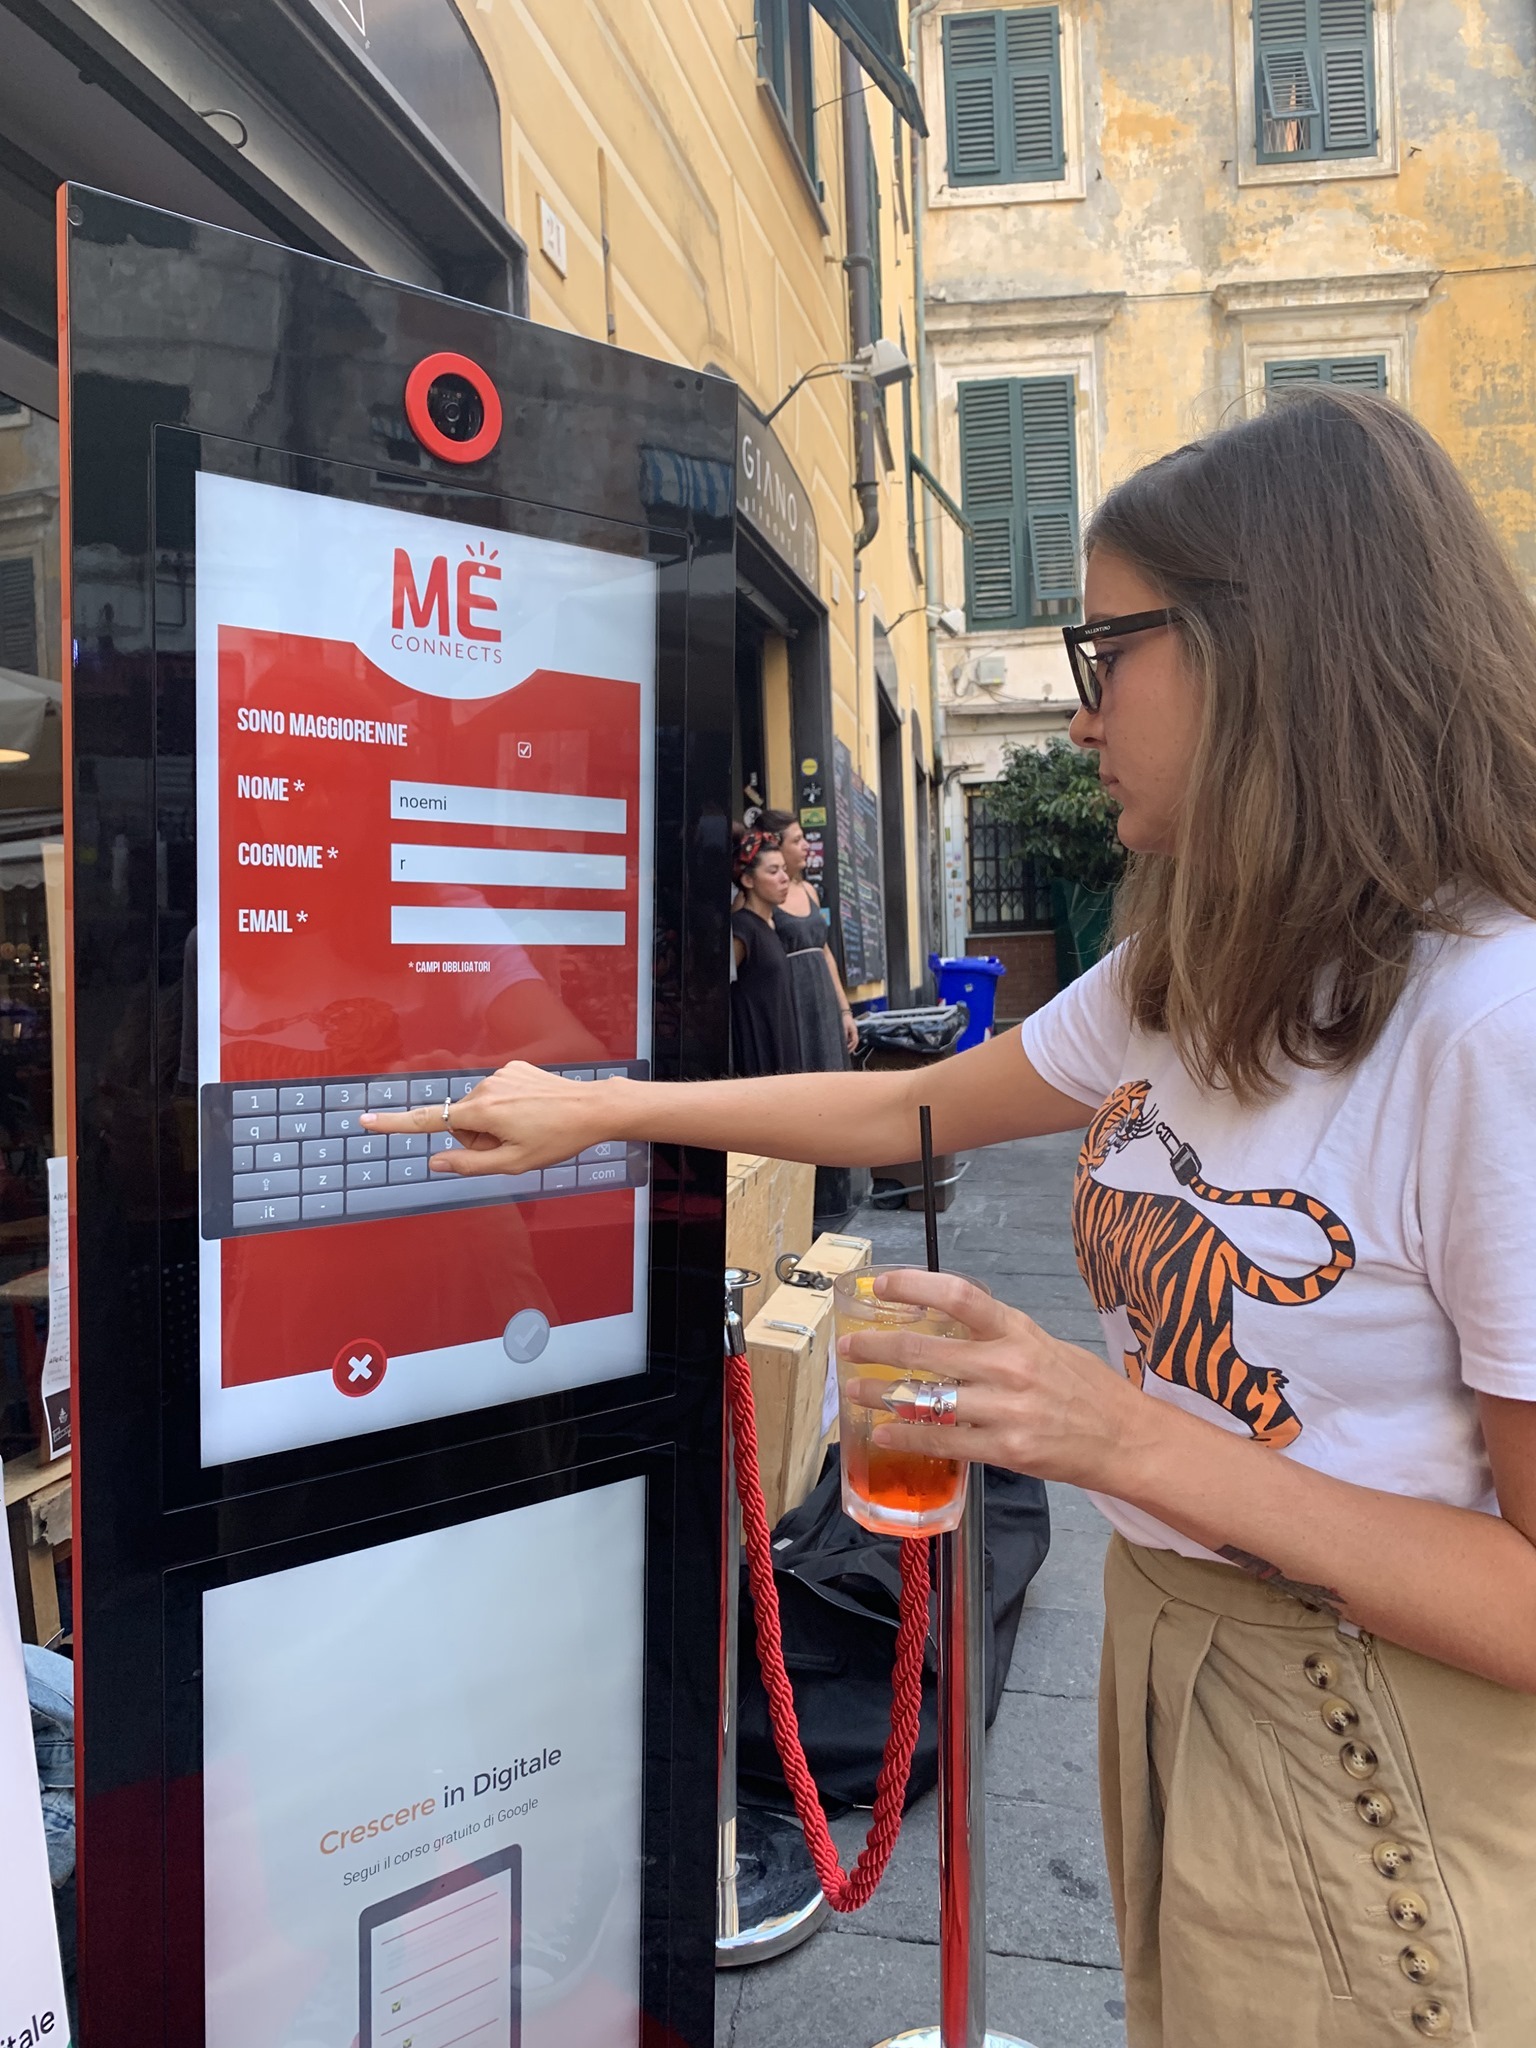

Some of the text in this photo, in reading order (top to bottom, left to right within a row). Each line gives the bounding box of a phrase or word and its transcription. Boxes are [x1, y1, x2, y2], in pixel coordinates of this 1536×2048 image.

[742, 435, 798, 531] GIANO
[392, 547, 501, 643] ME
[391, 634, 502, 664] CONNECTS
[237, 707, 408, 747] SONO MAGGIORENNE
[237, 774, 290, 802] NOME
[399, 796, 447, 811] noemi
[238, 842, 323, 869] COGNOME
[399, 858, 406, 870] r
[238, 909, 294, 933] EMAIL
[415, 961, 491, 973] CAMPI OBBLIGATORI
[250, 1082, 472, 1109] 1 2 3 4 5 6
[249, 1119, 350, 1139] q w e
[272, 1151, 282, 1162] a
[318, 1147, 327, 1158] s
[362, 1141, 371, 1154] d
[405, 1137, 412, 1150] f
[444, 1137, 453, 1149] g
[318, 1166, 412, 1185] z x c
[589, 1169, 616, 1181] .com
[260, 1205, 275, 1219] .it
[319, 1748, 562, 1855] Crescere in Digitale
[342, 1797, 539, 1886] Segui il corso gratuito di Google
